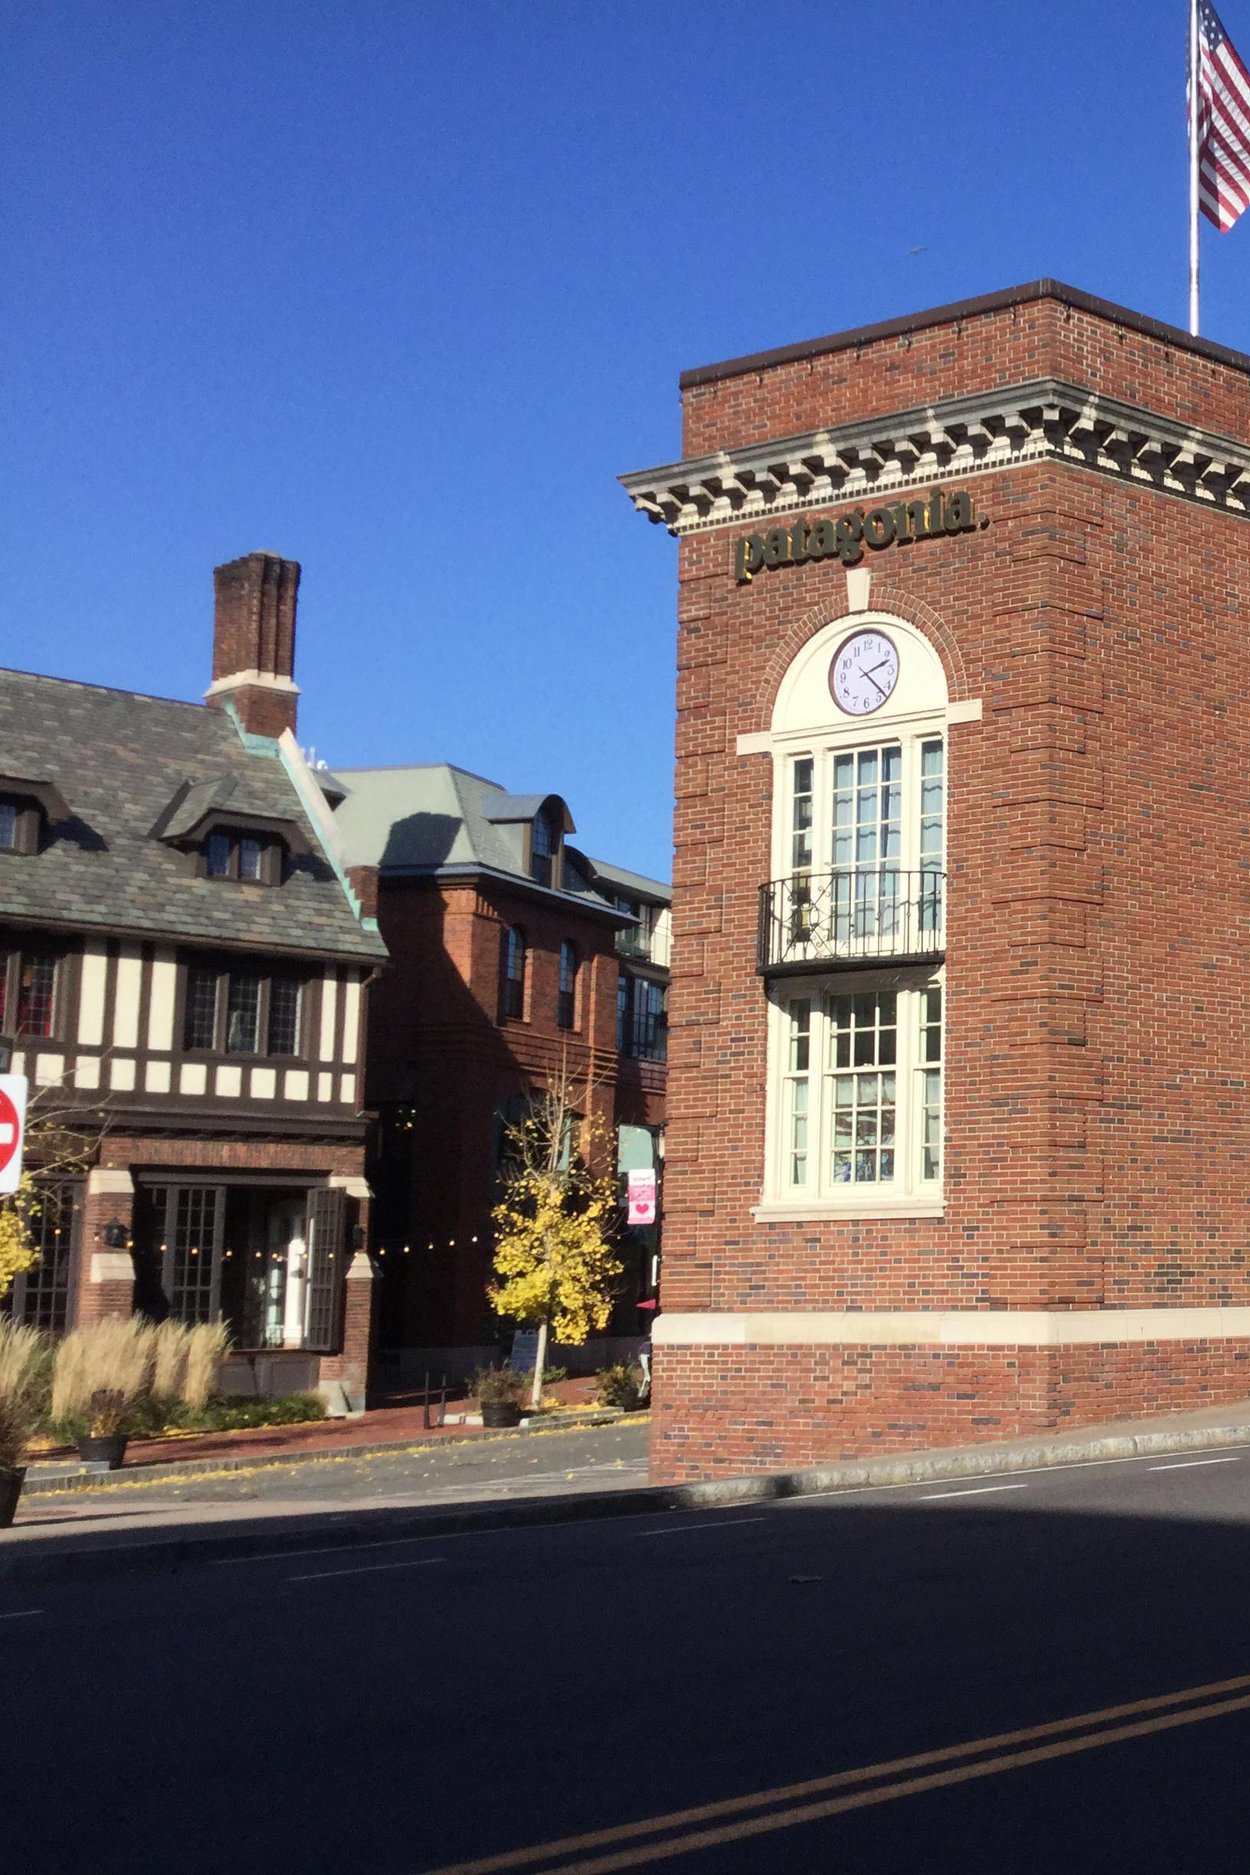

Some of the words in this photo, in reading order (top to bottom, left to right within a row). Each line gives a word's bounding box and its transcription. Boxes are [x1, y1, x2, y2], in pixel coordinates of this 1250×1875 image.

[735, 487, 975, 583] patagonia
[864, 638, 873, 651] 12
[854, 646, 860, 657] 11
[843, 658, 852, 670] 10
[887, 664, 895, 676] 3
[840, 672, 847, 683] 9
[883, 680, 891, 690] 4
[843, 687, 850, 698] 8
[852, 696, 859, 706] 7
[863, 697, 870, 709] 6
